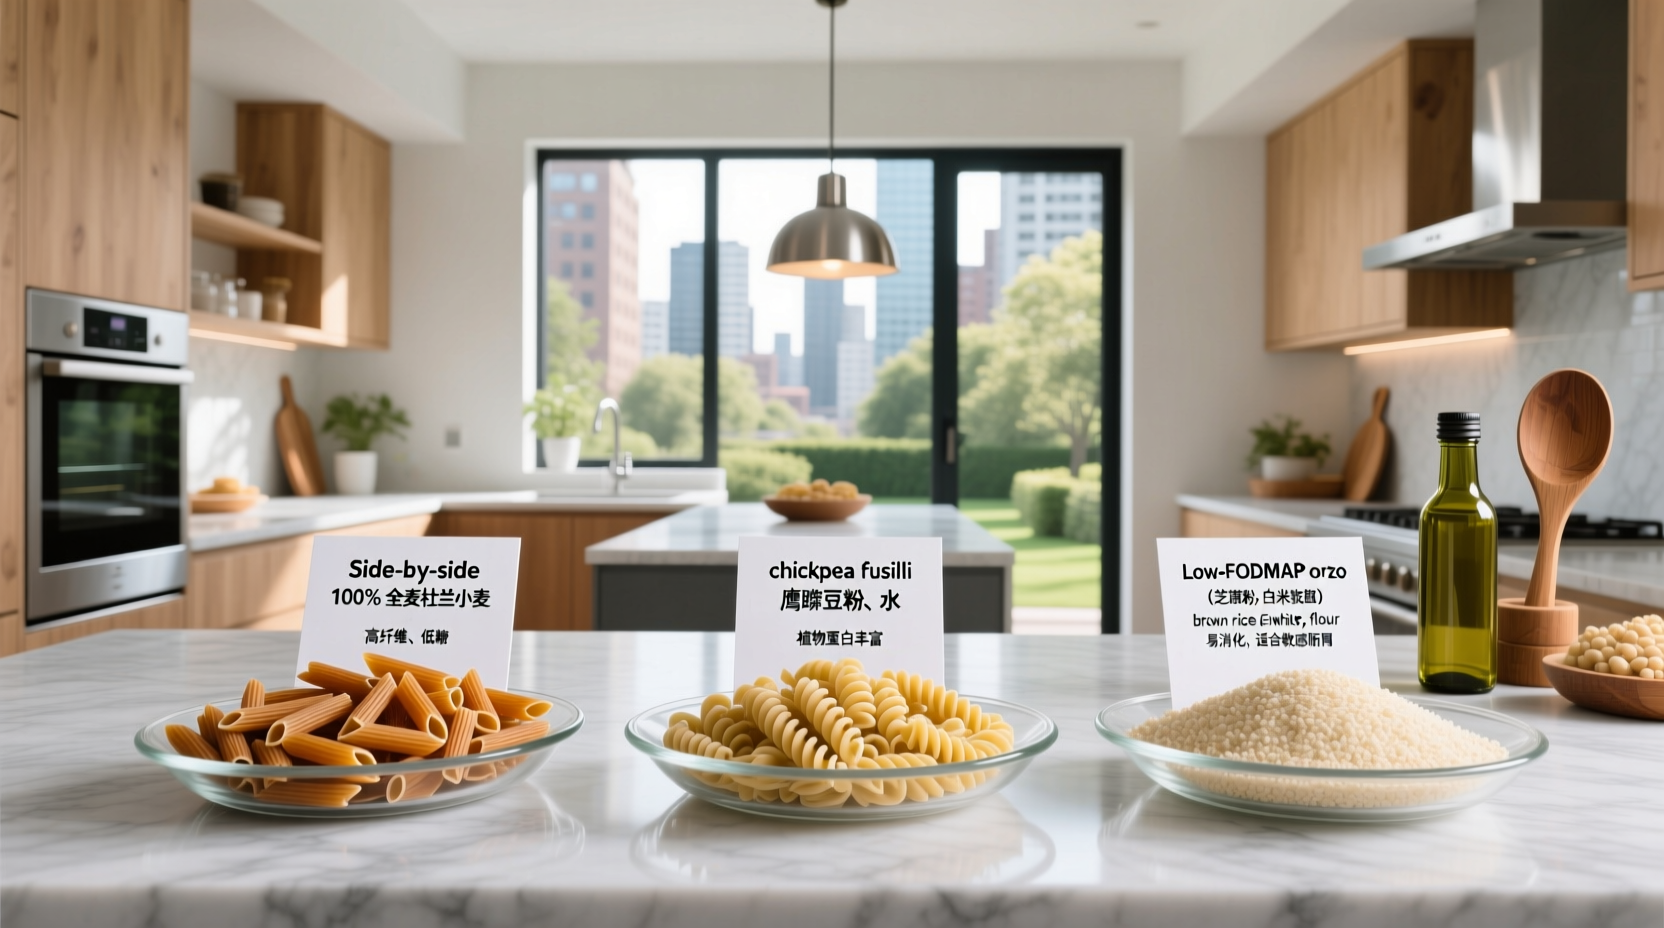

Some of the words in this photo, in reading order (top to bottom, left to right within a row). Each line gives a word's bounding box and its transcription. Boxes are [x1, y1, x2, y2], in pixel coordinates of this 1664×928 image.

[348, 558, 480, 584] Side-by-side
[768, 560, 855, 584] chickpea
[861, 560, 912, 580] fusilli
[1182, 562, 1306, 580] Low-FODMAP
[1309, 565, 1347, 579] orzo
[331, 587, 382, 606] 100%
[385, 586, 491, 608] 全麦杜兰小麦
[1232, 612, 1257, 627] rice
[1309, 611, 1340, 626] flour
